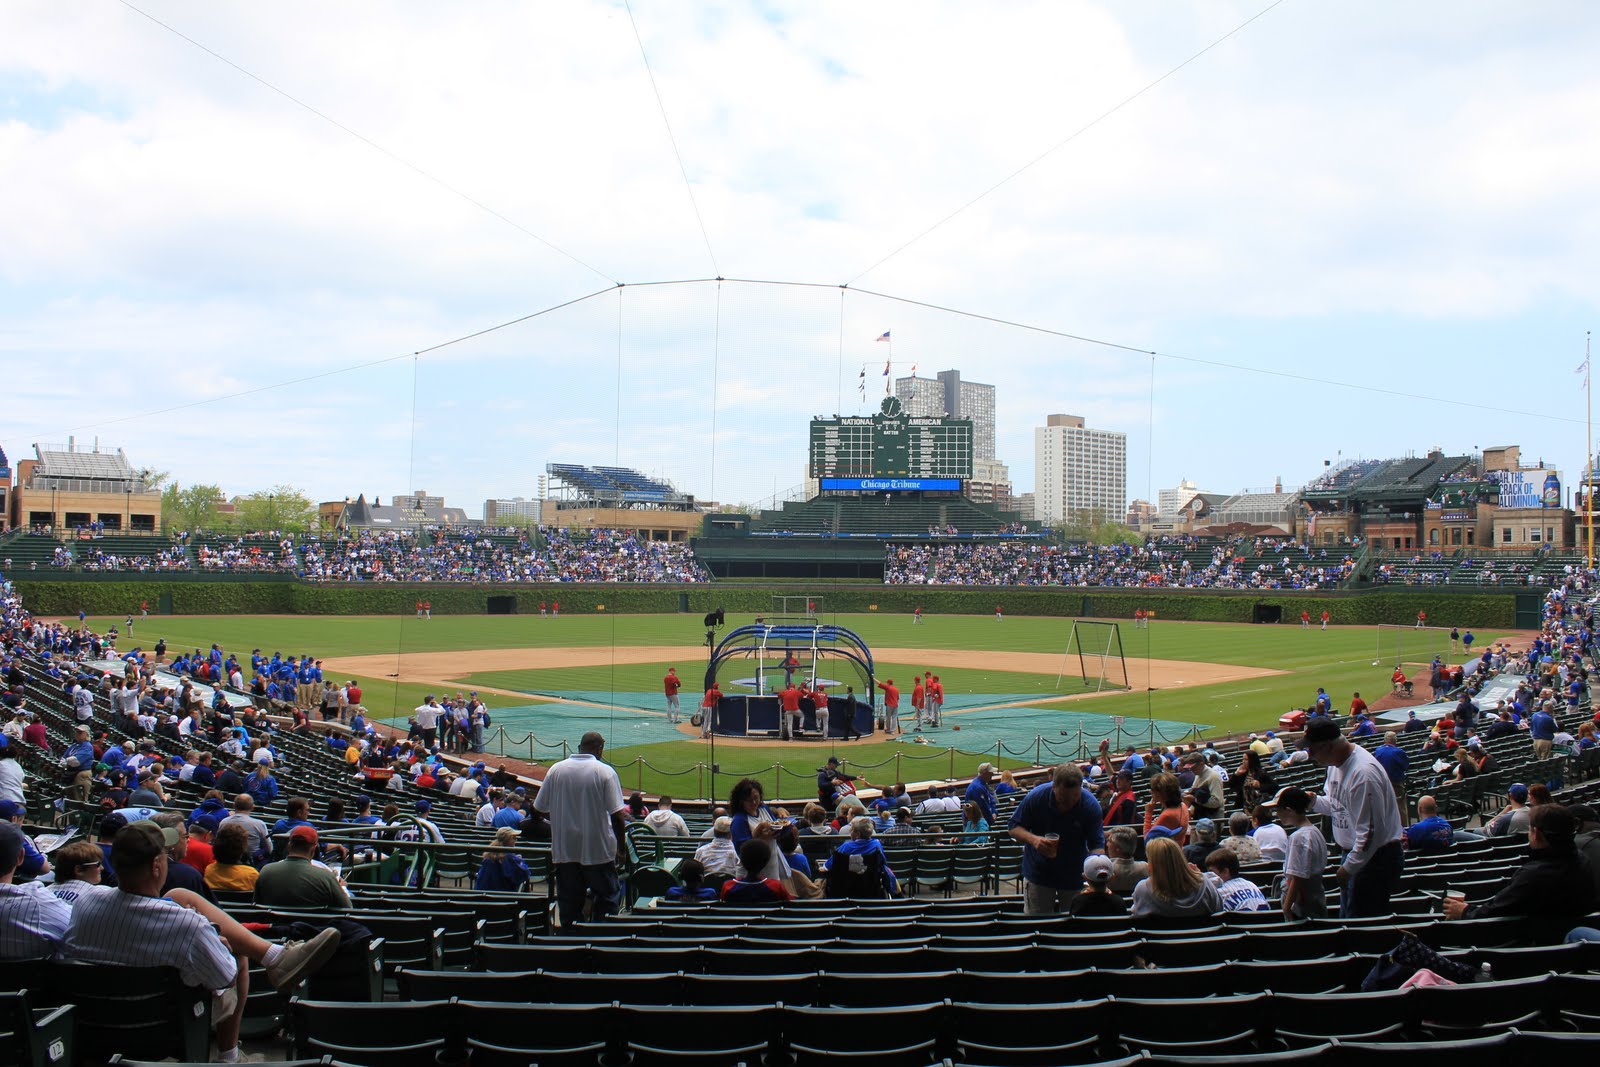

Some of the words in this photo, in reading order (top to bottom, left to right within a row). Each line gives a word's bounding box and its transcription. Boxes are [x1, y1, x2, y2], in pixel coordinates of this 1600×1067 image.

[1510, 472, 1524, 484] THE
[861, 480, 890, 489] Chicago
[891, 480, 920, 489] Tribune
[1499, 483, 1523, 495] CRACK
[1524, 482, 1534, 495] OF
